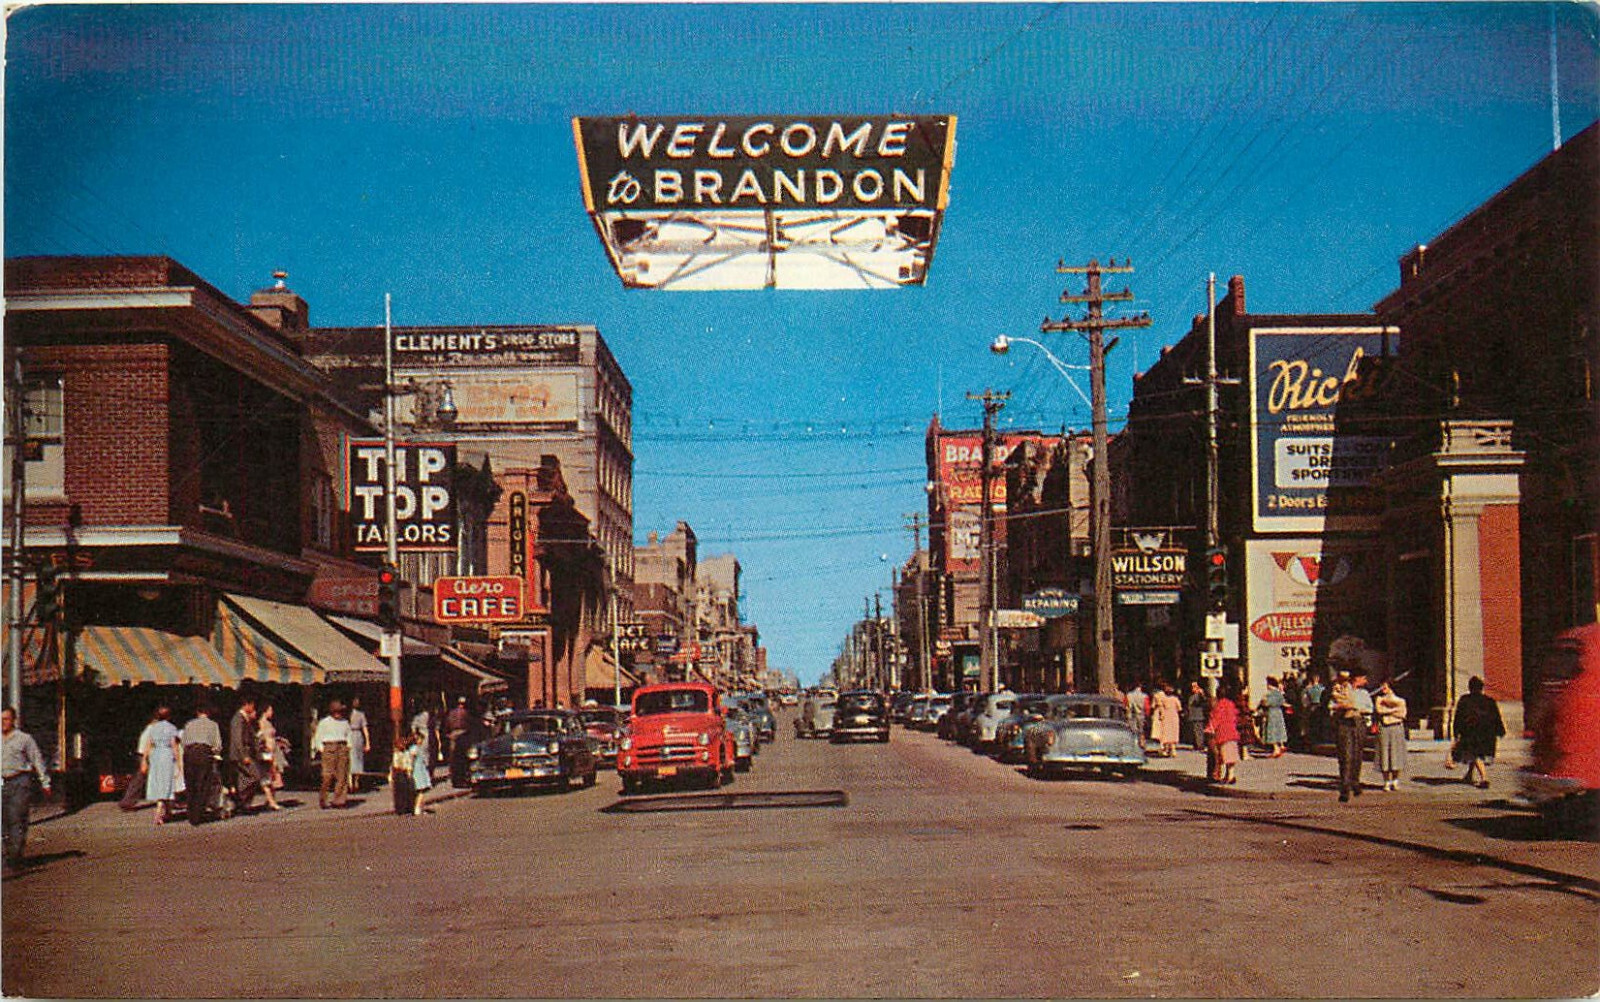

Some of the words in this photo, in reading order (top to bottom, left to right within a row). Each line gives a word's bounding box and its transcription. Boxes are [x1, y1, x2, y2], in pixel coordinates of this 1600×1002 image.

[617, 121, 915, 159] WELCOME
[607, 170, 642, 205] to
[654, 168, 926, 204] BRANDON
[395, 330, 498, 351] CLEMENT'S
[1286, 444, 1331, 455] SUITS
[356, 447, 446, 483] TIP
[354, 484, 450, 520] TOP
[1112, 554, 1186, 573] WILLSON
[453, 579, 504, 594] Aero
[1114, 574, 1184, 585] STATIONERY
[442, 598, 516, 617] CAFE
